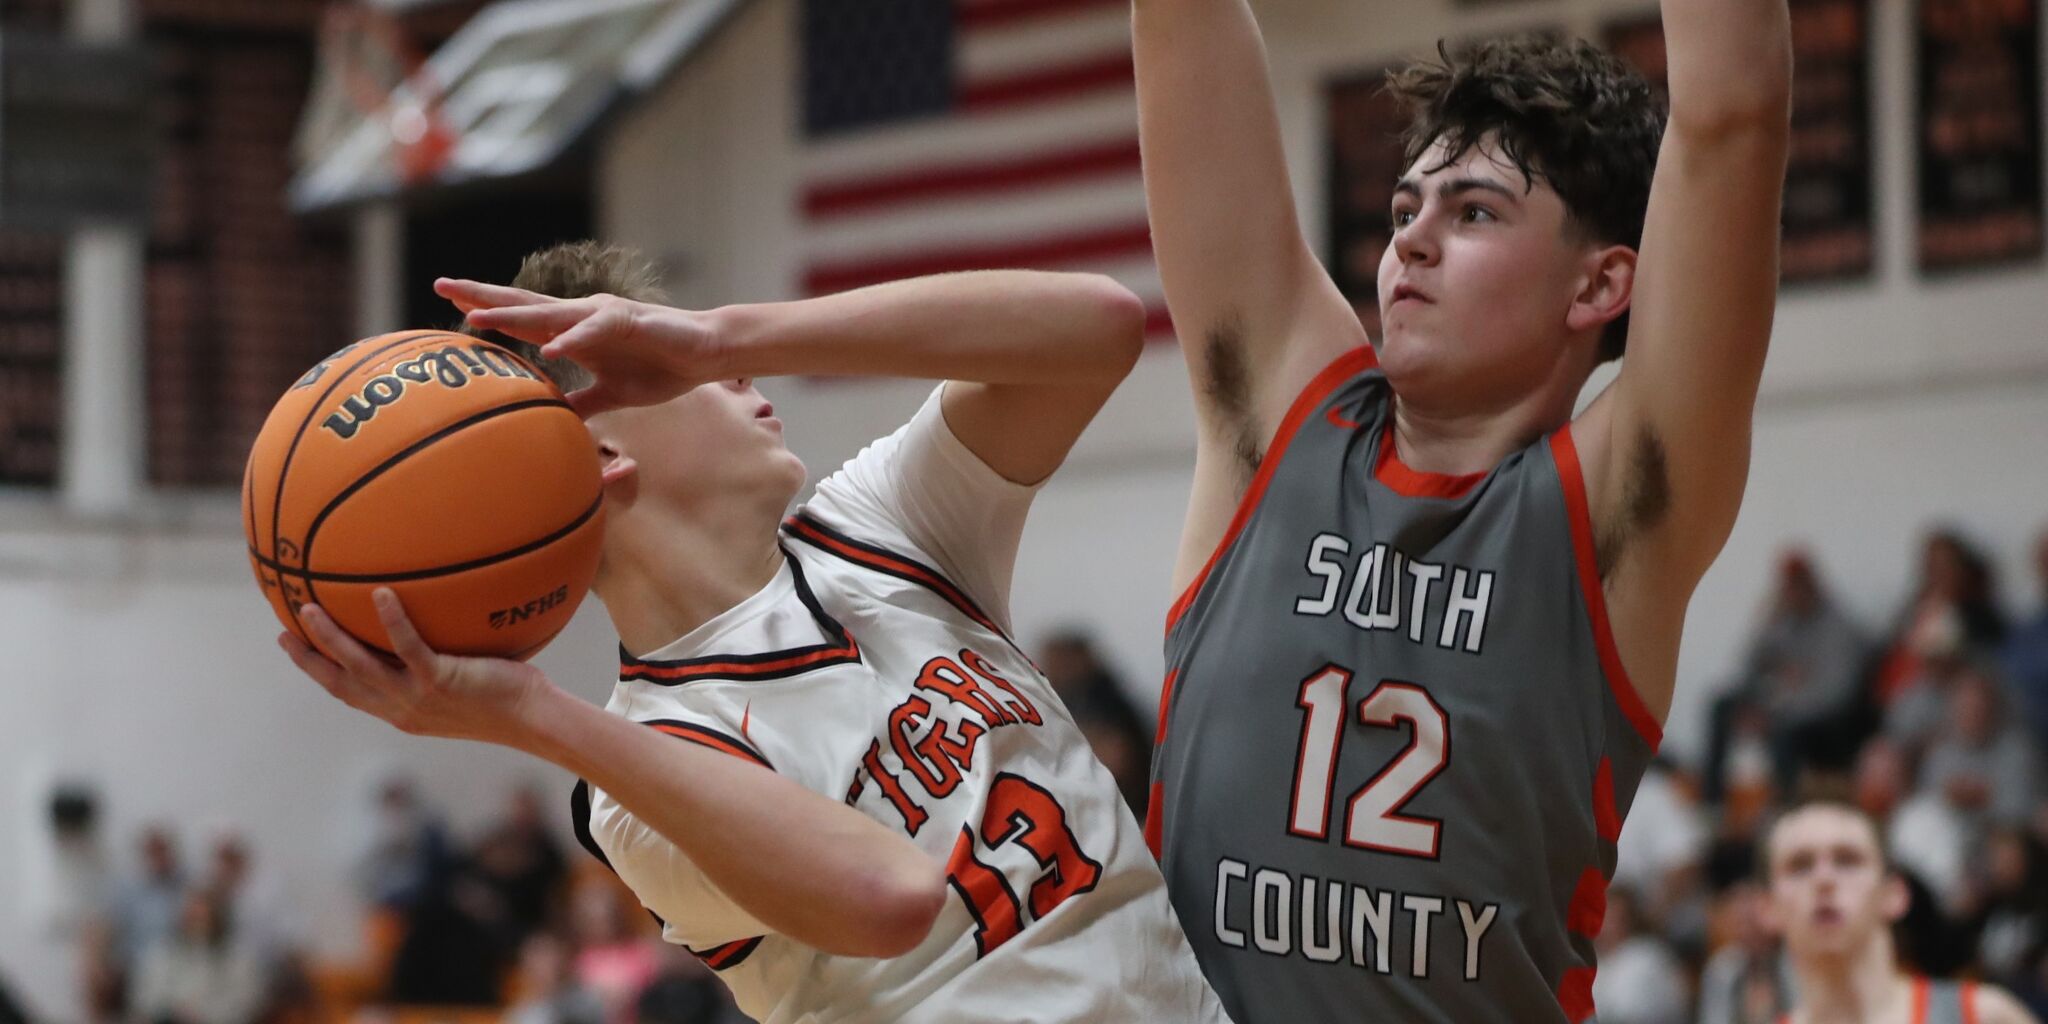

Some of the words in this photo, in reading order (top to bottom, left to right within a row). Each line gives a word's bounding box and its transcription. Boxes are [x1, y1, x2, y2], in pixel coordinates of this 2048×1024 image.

[320, 344, 545, 440] Wilson
[1293, 531, 1496, 655] SOUTH
[846, 648, 1043, 838] IGERS
[1286, 662, 1450, 861] 12
[1213, 856, 1499, 981] COUNTY
